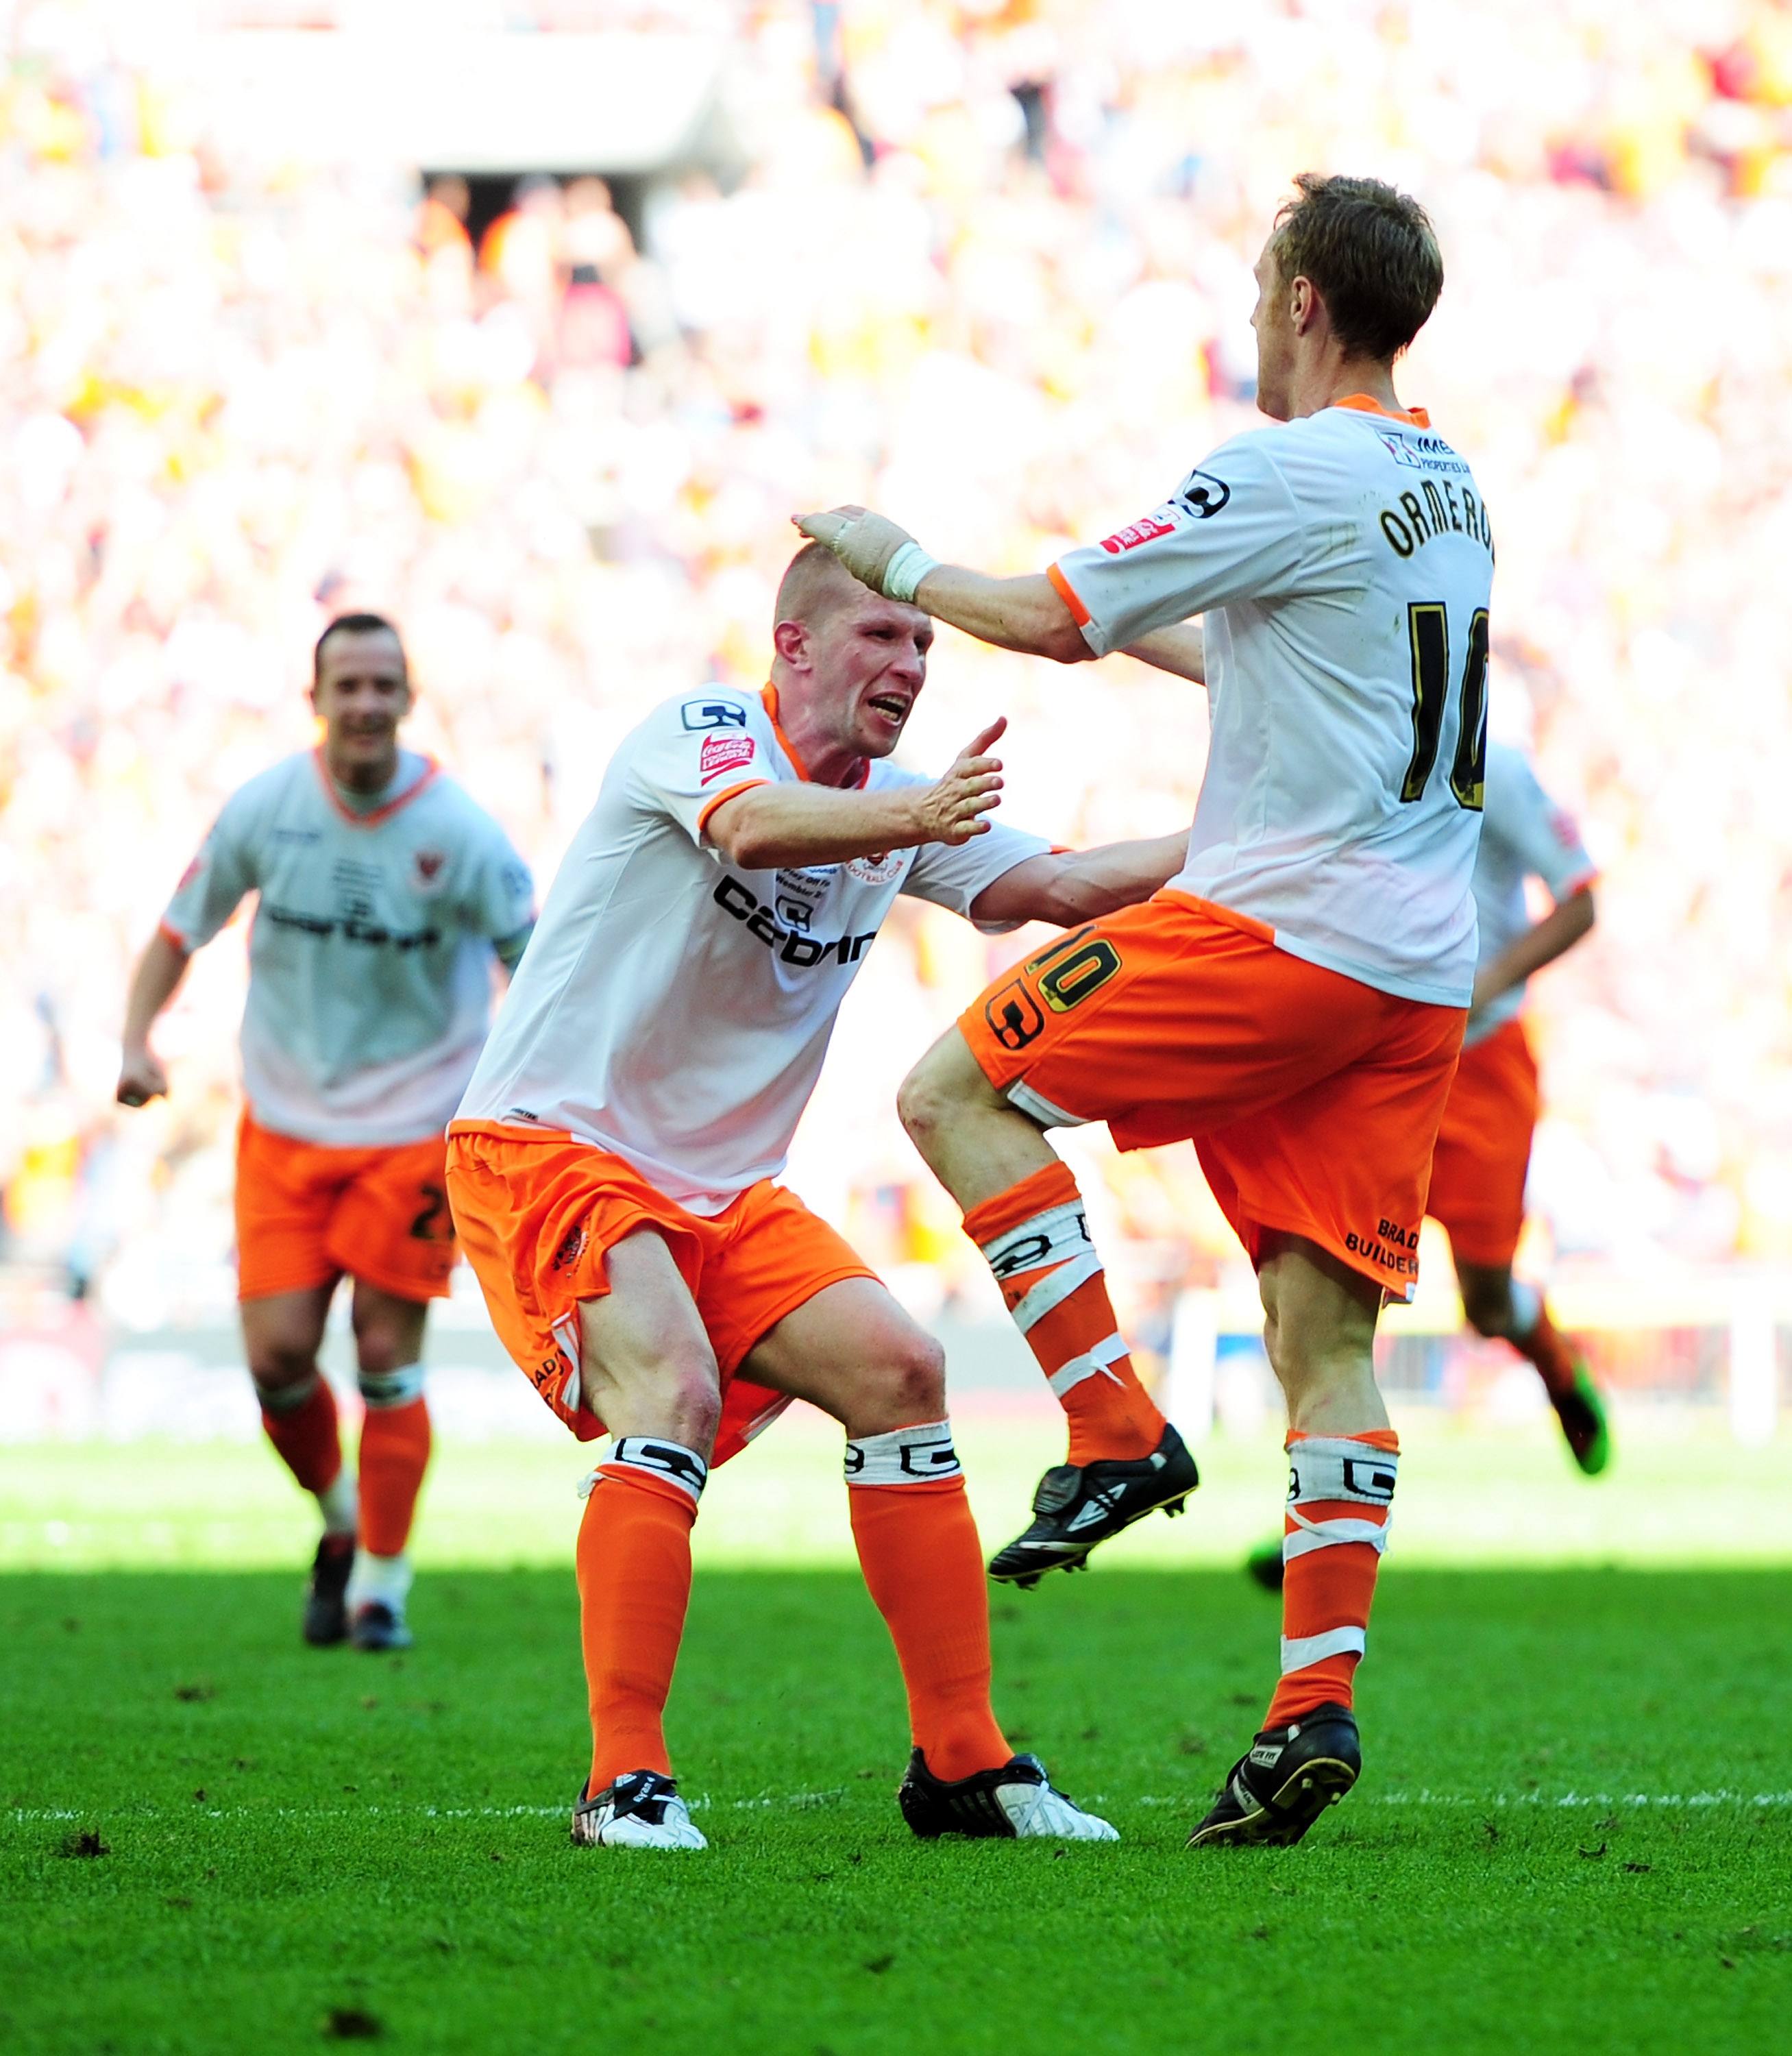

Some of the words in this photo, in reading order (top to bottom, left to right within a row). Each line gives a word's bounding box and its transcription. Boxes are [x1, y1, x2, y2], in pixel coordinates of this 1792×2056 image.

[1379, 478, 1495, 567] ORMERO
[1399, 601, 1489, 811] 10
[1024, 925, 1122, 1013] 10
[410, 1182, 456, 1241] 2
